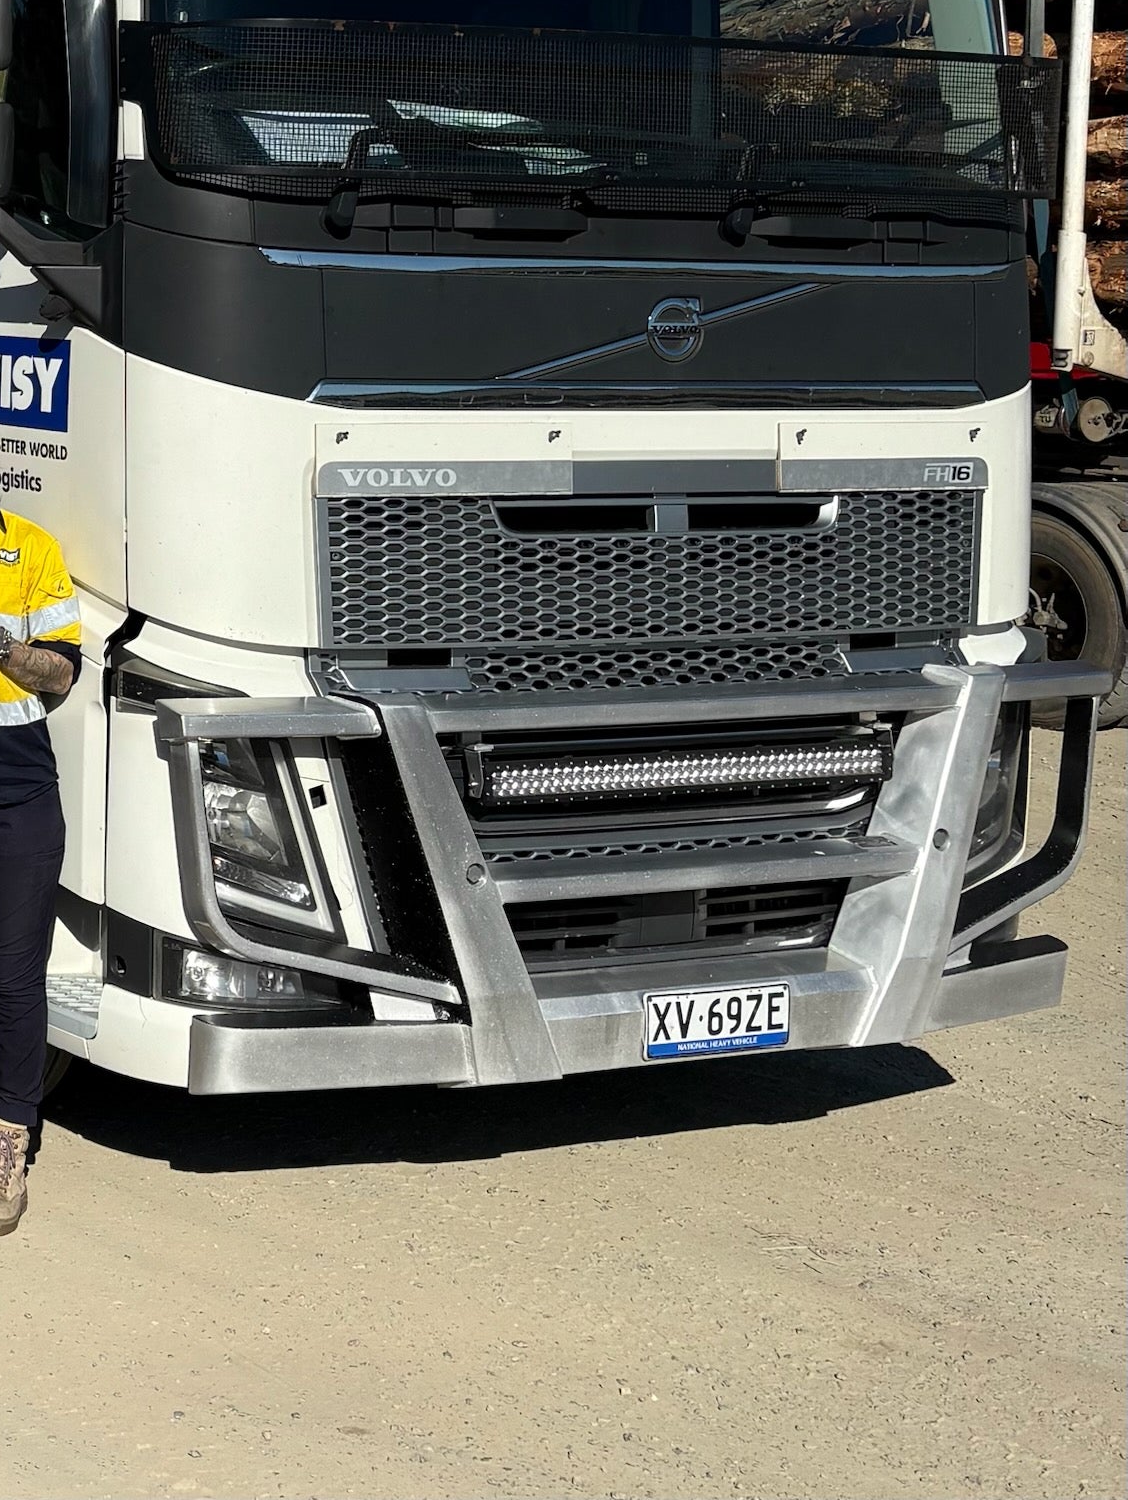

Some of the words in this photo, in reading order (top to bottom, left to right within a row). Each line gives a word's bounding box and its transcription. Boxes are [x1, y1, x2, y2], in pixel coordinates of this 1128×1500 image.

[651, 324, 701, 335] VOLVO
[29, 441, 68, 461] WORLD
[337, 467, 457, 487] VOLVO
[923, 463, 973, 482] FH16
[677, 1041, 710, 1052] NATIONAL
[709, 1038, 731, 1048] HEAVY
[732, 1036, 759, 1046] VEHICLE
